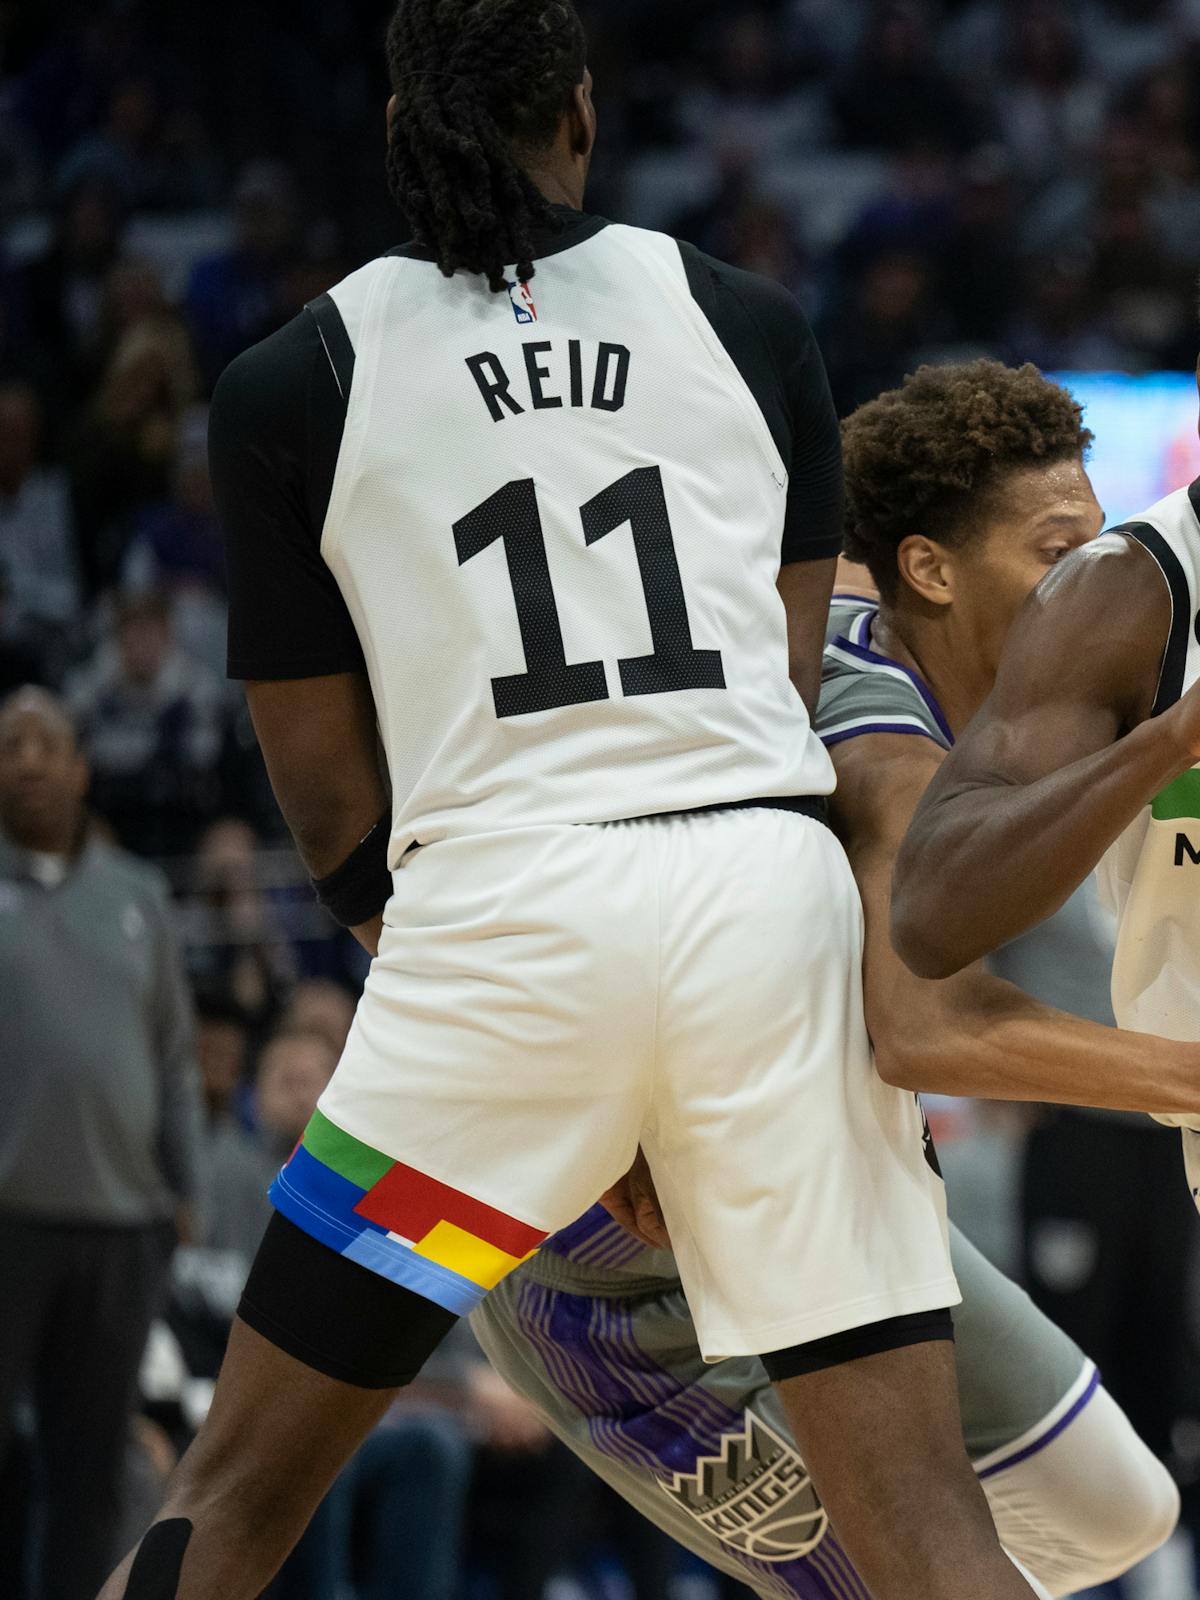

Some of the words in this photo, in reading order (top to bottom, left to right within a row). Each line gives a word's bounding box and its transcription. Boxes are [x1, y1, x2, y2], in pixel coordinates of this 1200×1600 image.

[465, 339, 630, 423] REID
[452, 465, 727, 719] 11
[701, 1455, 808, 1535] KINGS
